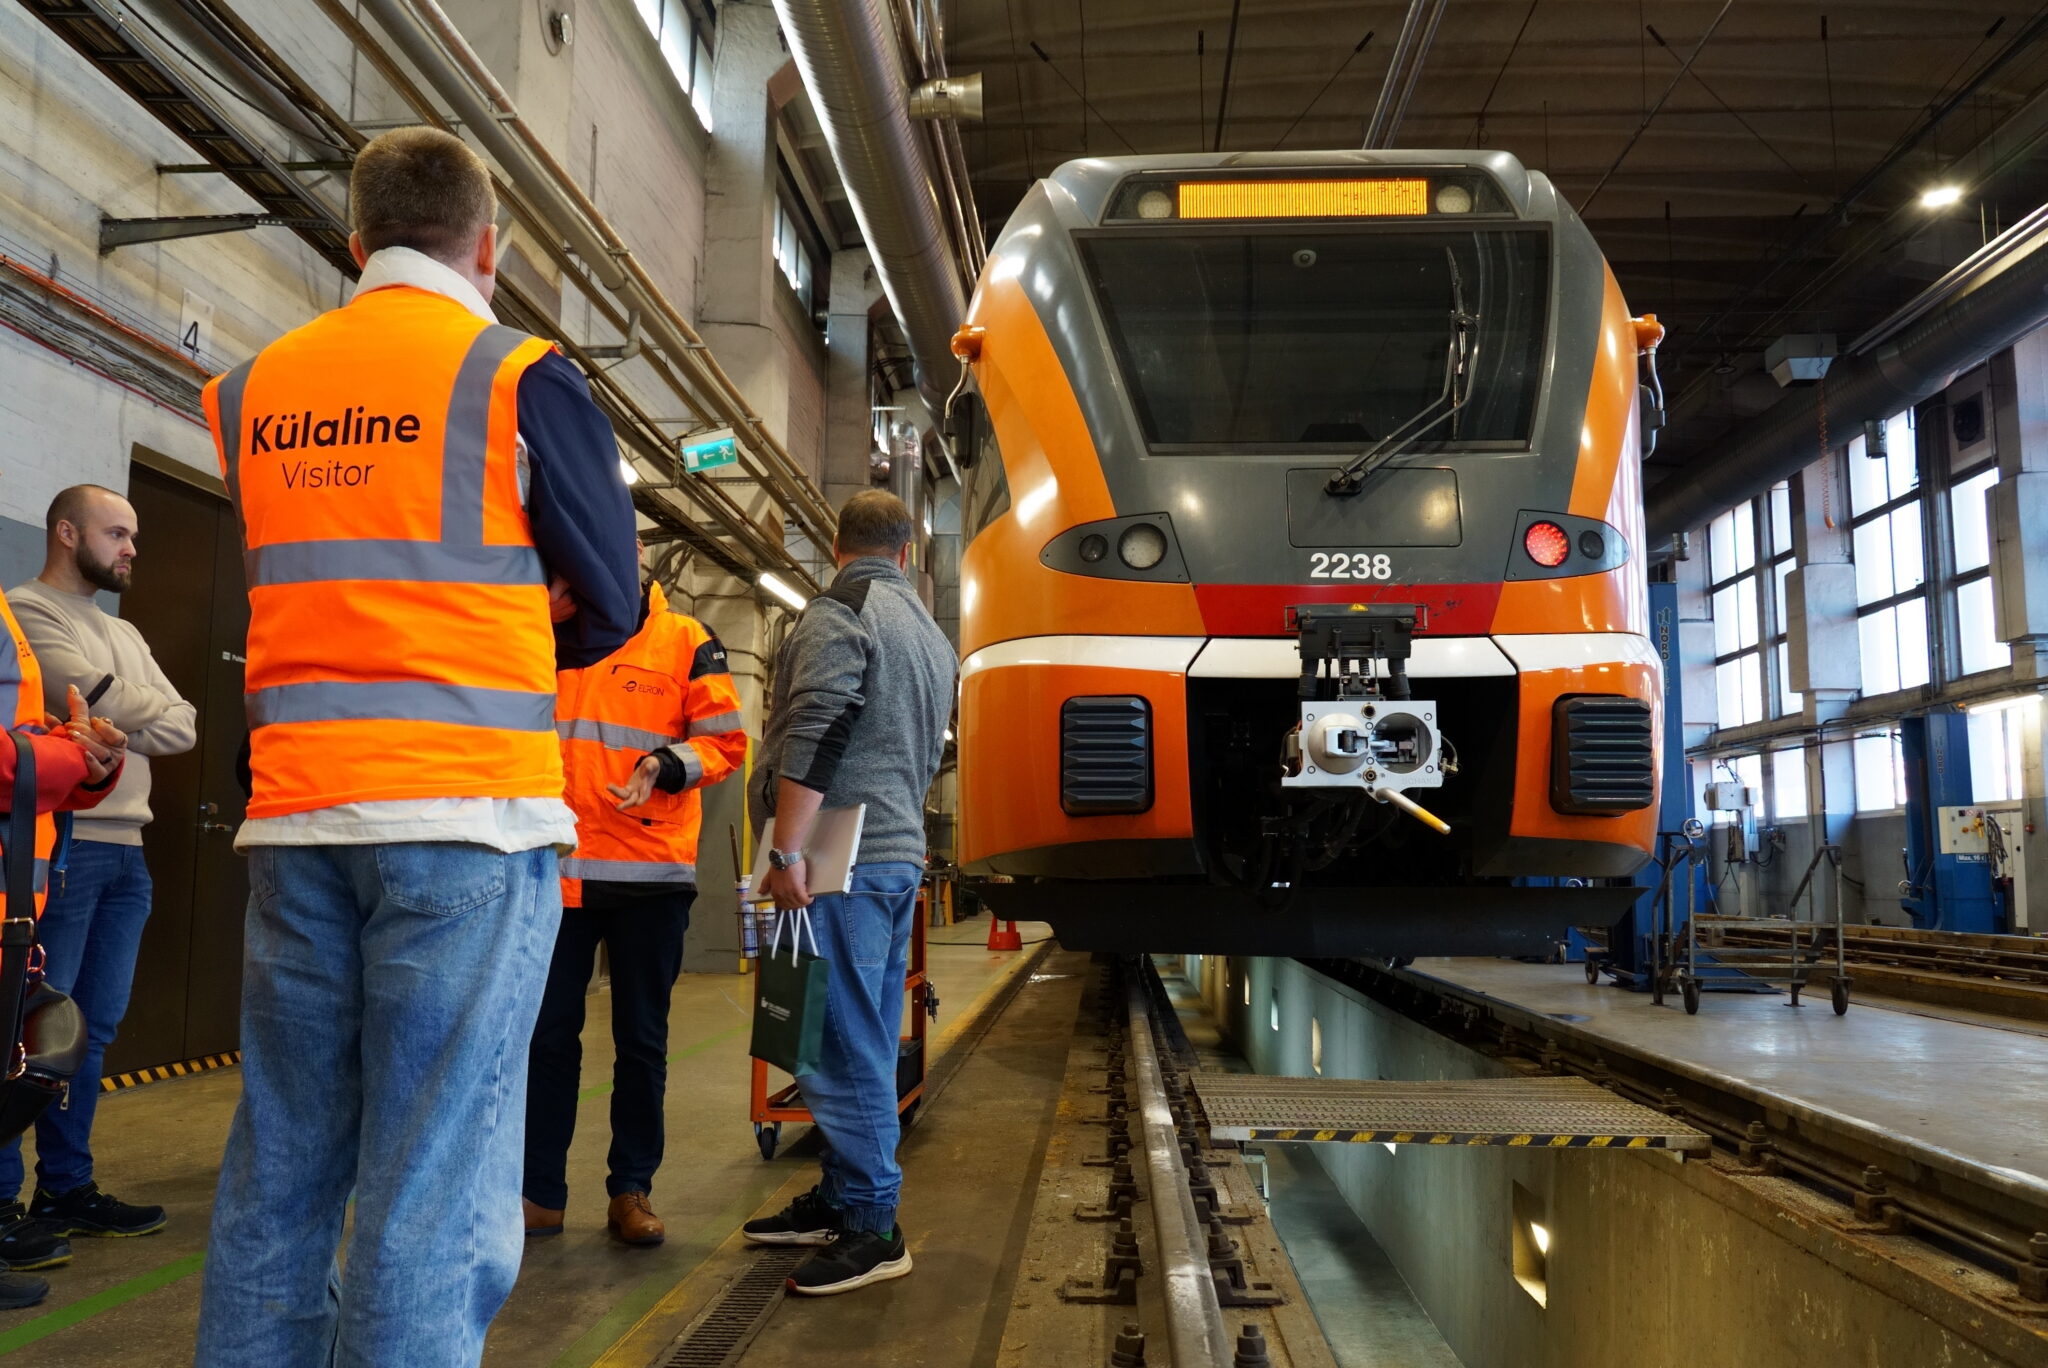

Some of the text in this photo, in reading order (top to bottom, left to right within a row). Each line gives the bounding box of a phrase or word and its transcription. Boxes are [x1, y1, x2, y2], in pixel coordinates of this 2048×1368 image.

[183, 320, 200, 354] 4
[251, 405, 421, 456] Külaline
[281, 460, 375, 489] Visitor
[1310, 552, 1392, 580] 2238
[1660, 625, 1670, 661] NORD
[638, 684, 665, 697] ELRON
